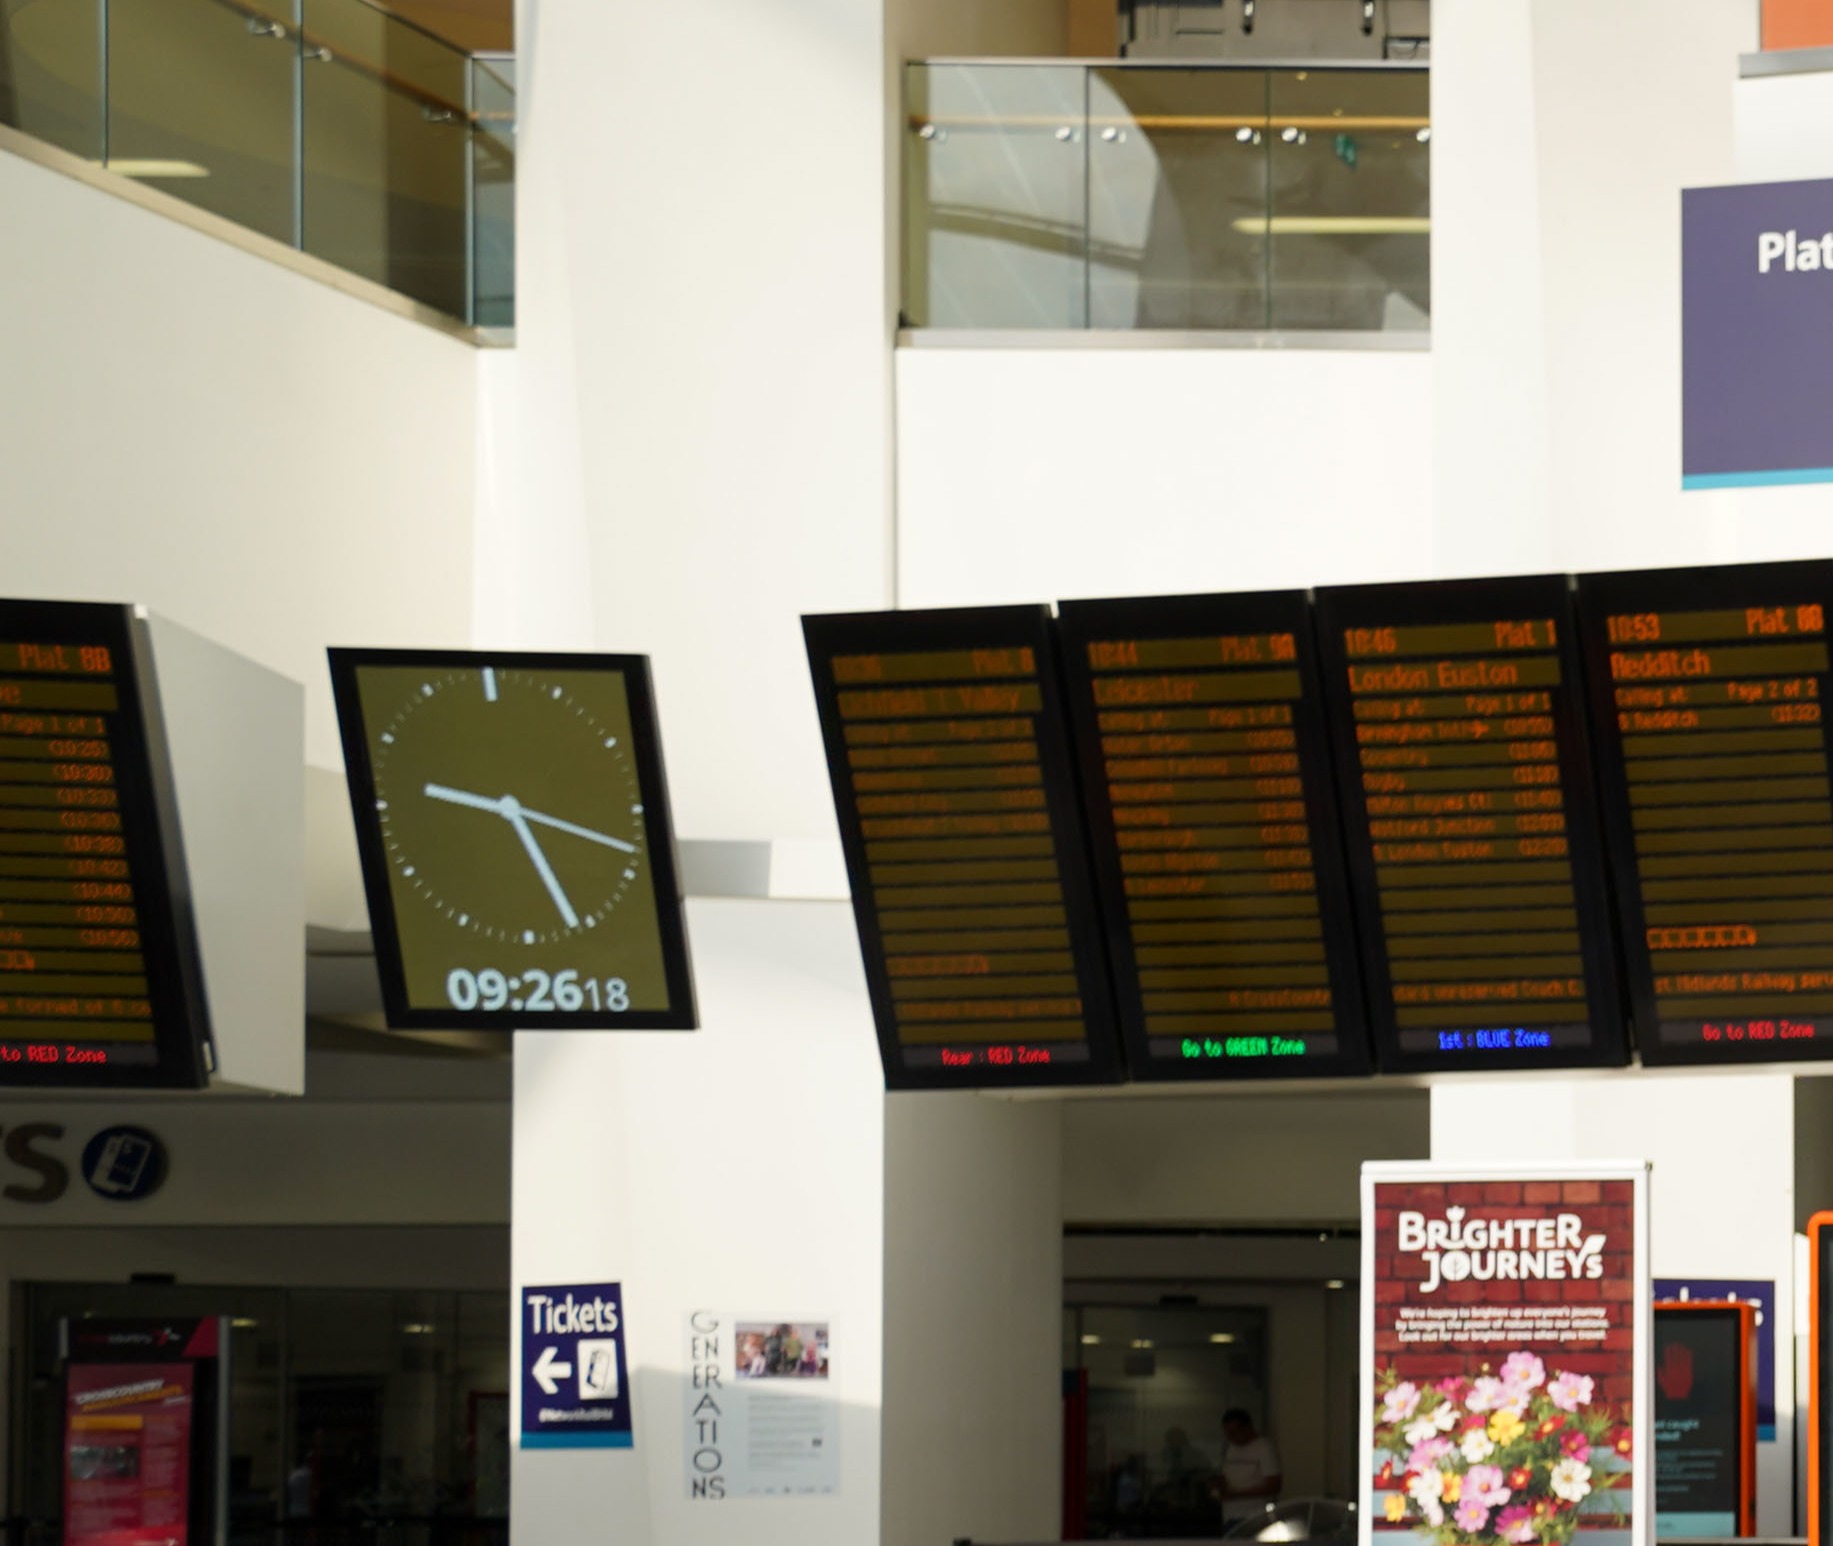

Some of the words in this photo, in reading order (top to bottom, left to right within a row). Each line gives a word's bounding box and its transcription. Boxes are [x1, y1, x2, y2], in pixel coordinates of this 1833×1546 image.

[1347, 665, 1430, 693] London
[1436, 660, 1518, 687] Euston
[1610, 650, 1711, 679] Redditch
[446, 968, 583, 1012] 09:26
[584, 976, 630, 1013] 18
[1398, 1206, 1582, 1251] BRIGHTER
[1419, 1243, 1605, 1293] JOURNEYS
[528, 1293, 618, 1334] Tickets
